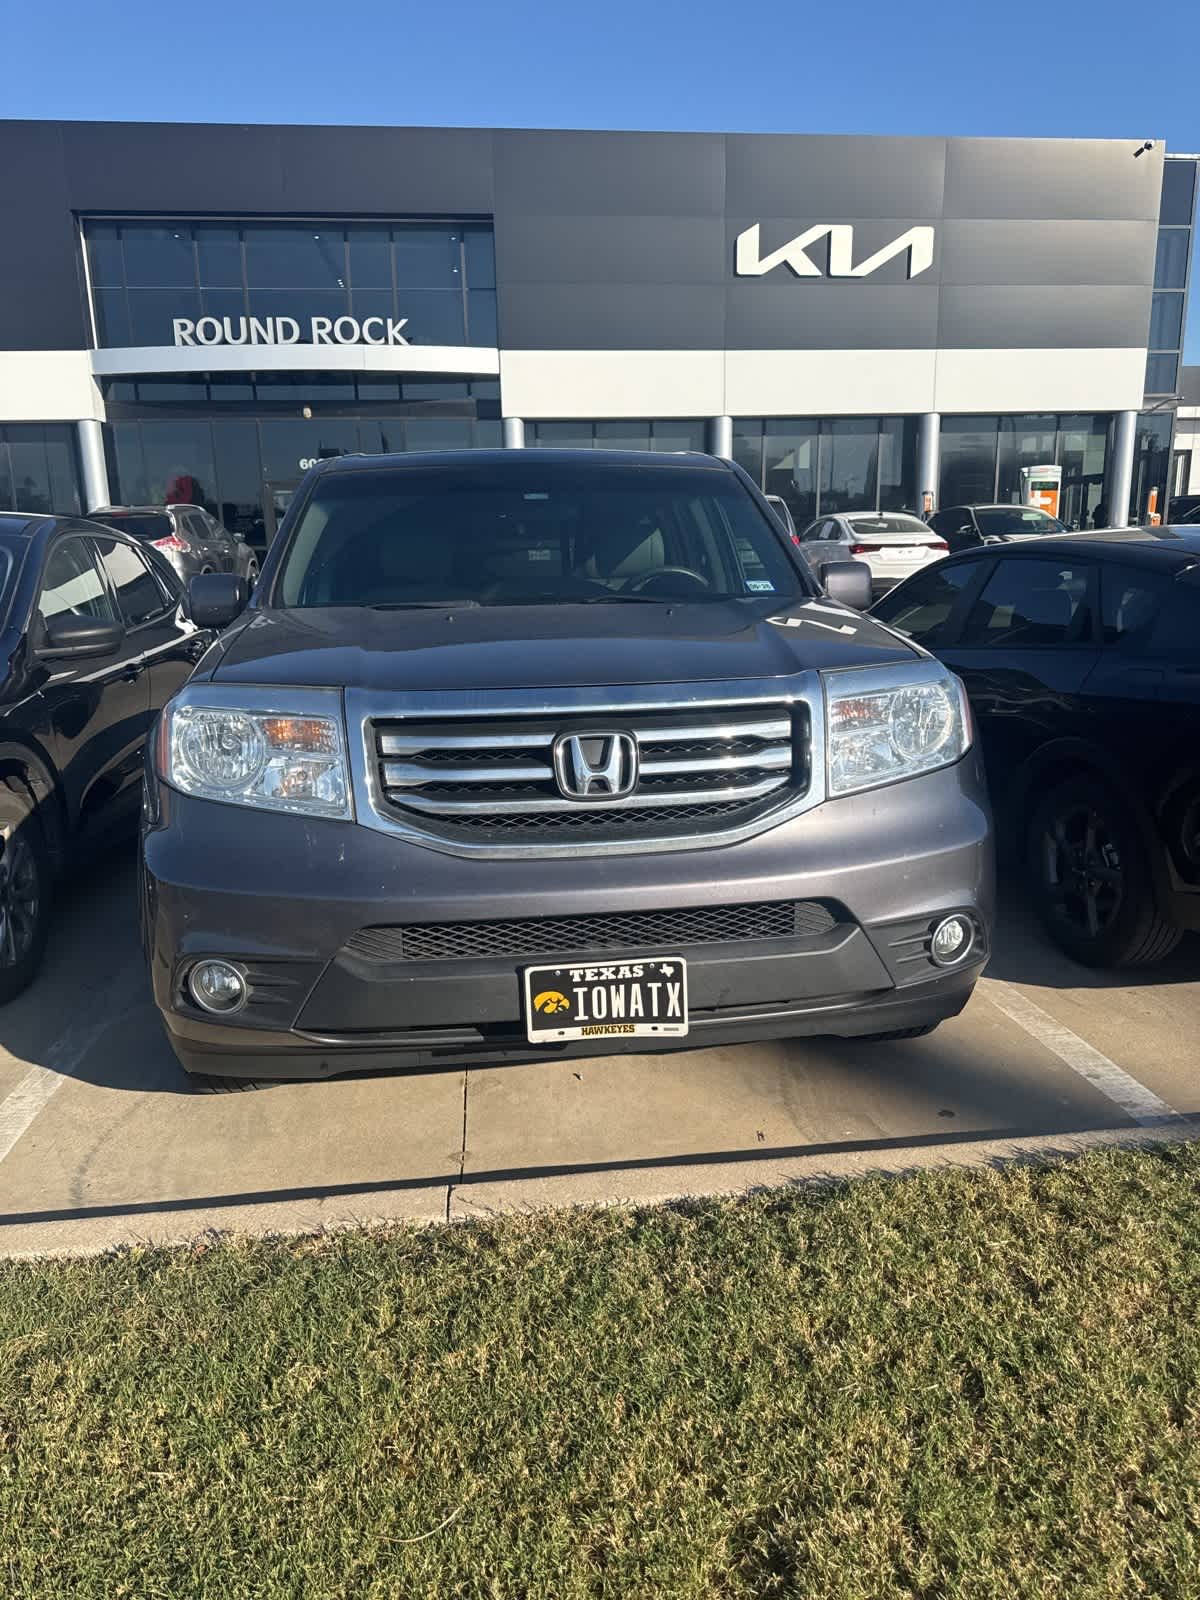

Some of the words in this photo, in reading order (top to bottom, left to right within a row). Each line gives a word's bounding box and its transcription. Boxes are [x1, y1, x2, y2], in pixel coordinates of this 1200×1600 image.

[737, 223, 935, 279] KIA
[173, 316, 300, 346] ROUND
[311, 316, 409, 345] ROCK
[569, 965, 644, 982] TEXAS
[573, 982, 682, 1021] IOWATX
[581, 1024, 635, 1036] HAWKEYES
